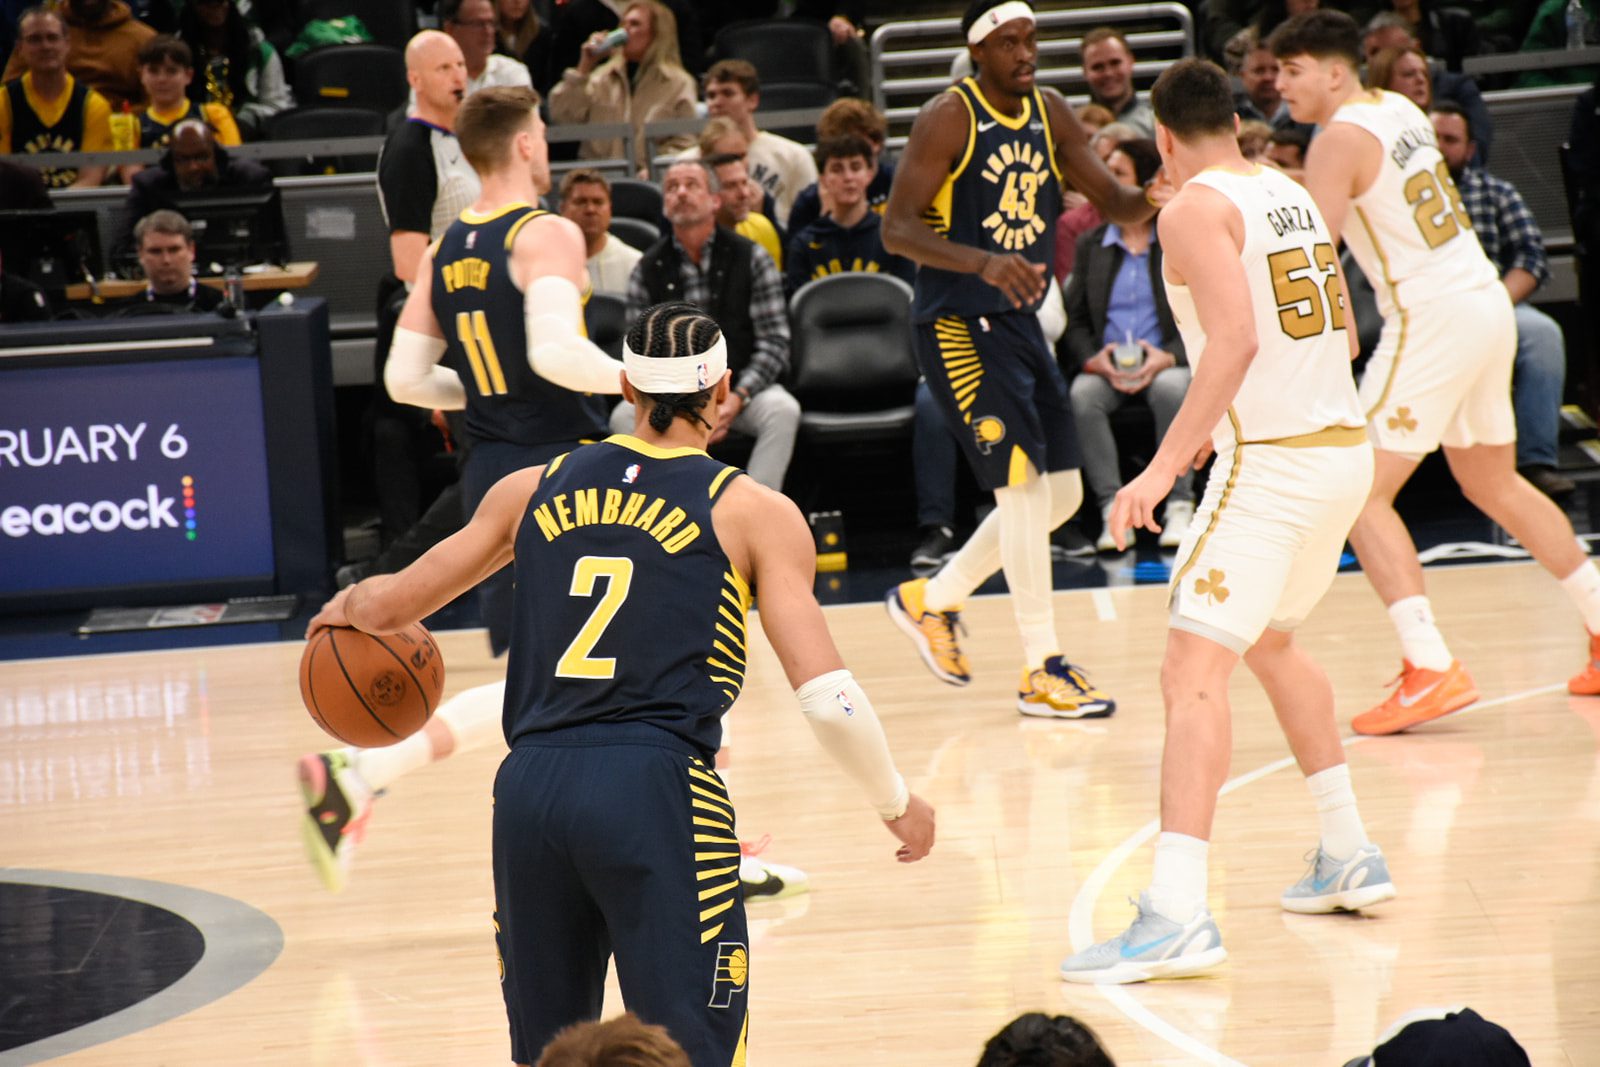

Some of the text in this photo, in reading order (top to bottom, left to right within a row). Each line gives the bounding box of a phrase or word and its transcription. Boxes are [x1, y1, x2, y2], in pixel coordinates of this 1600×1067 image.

[980, 140, 1050, 187] INDIANA
[998, 171, 1038, 220] 43
[981, 211, 1047, 250] PACERS
[1266, 206, 1317, 237] GARZA
[455, 309, 509, 397] 11
[0, 422, 189, 467] RUARY 6
[0, 484, 180, 538] eacock
[533, 487, 701, 554] NEMBHARD
[554, 555, 634, 680] 2
